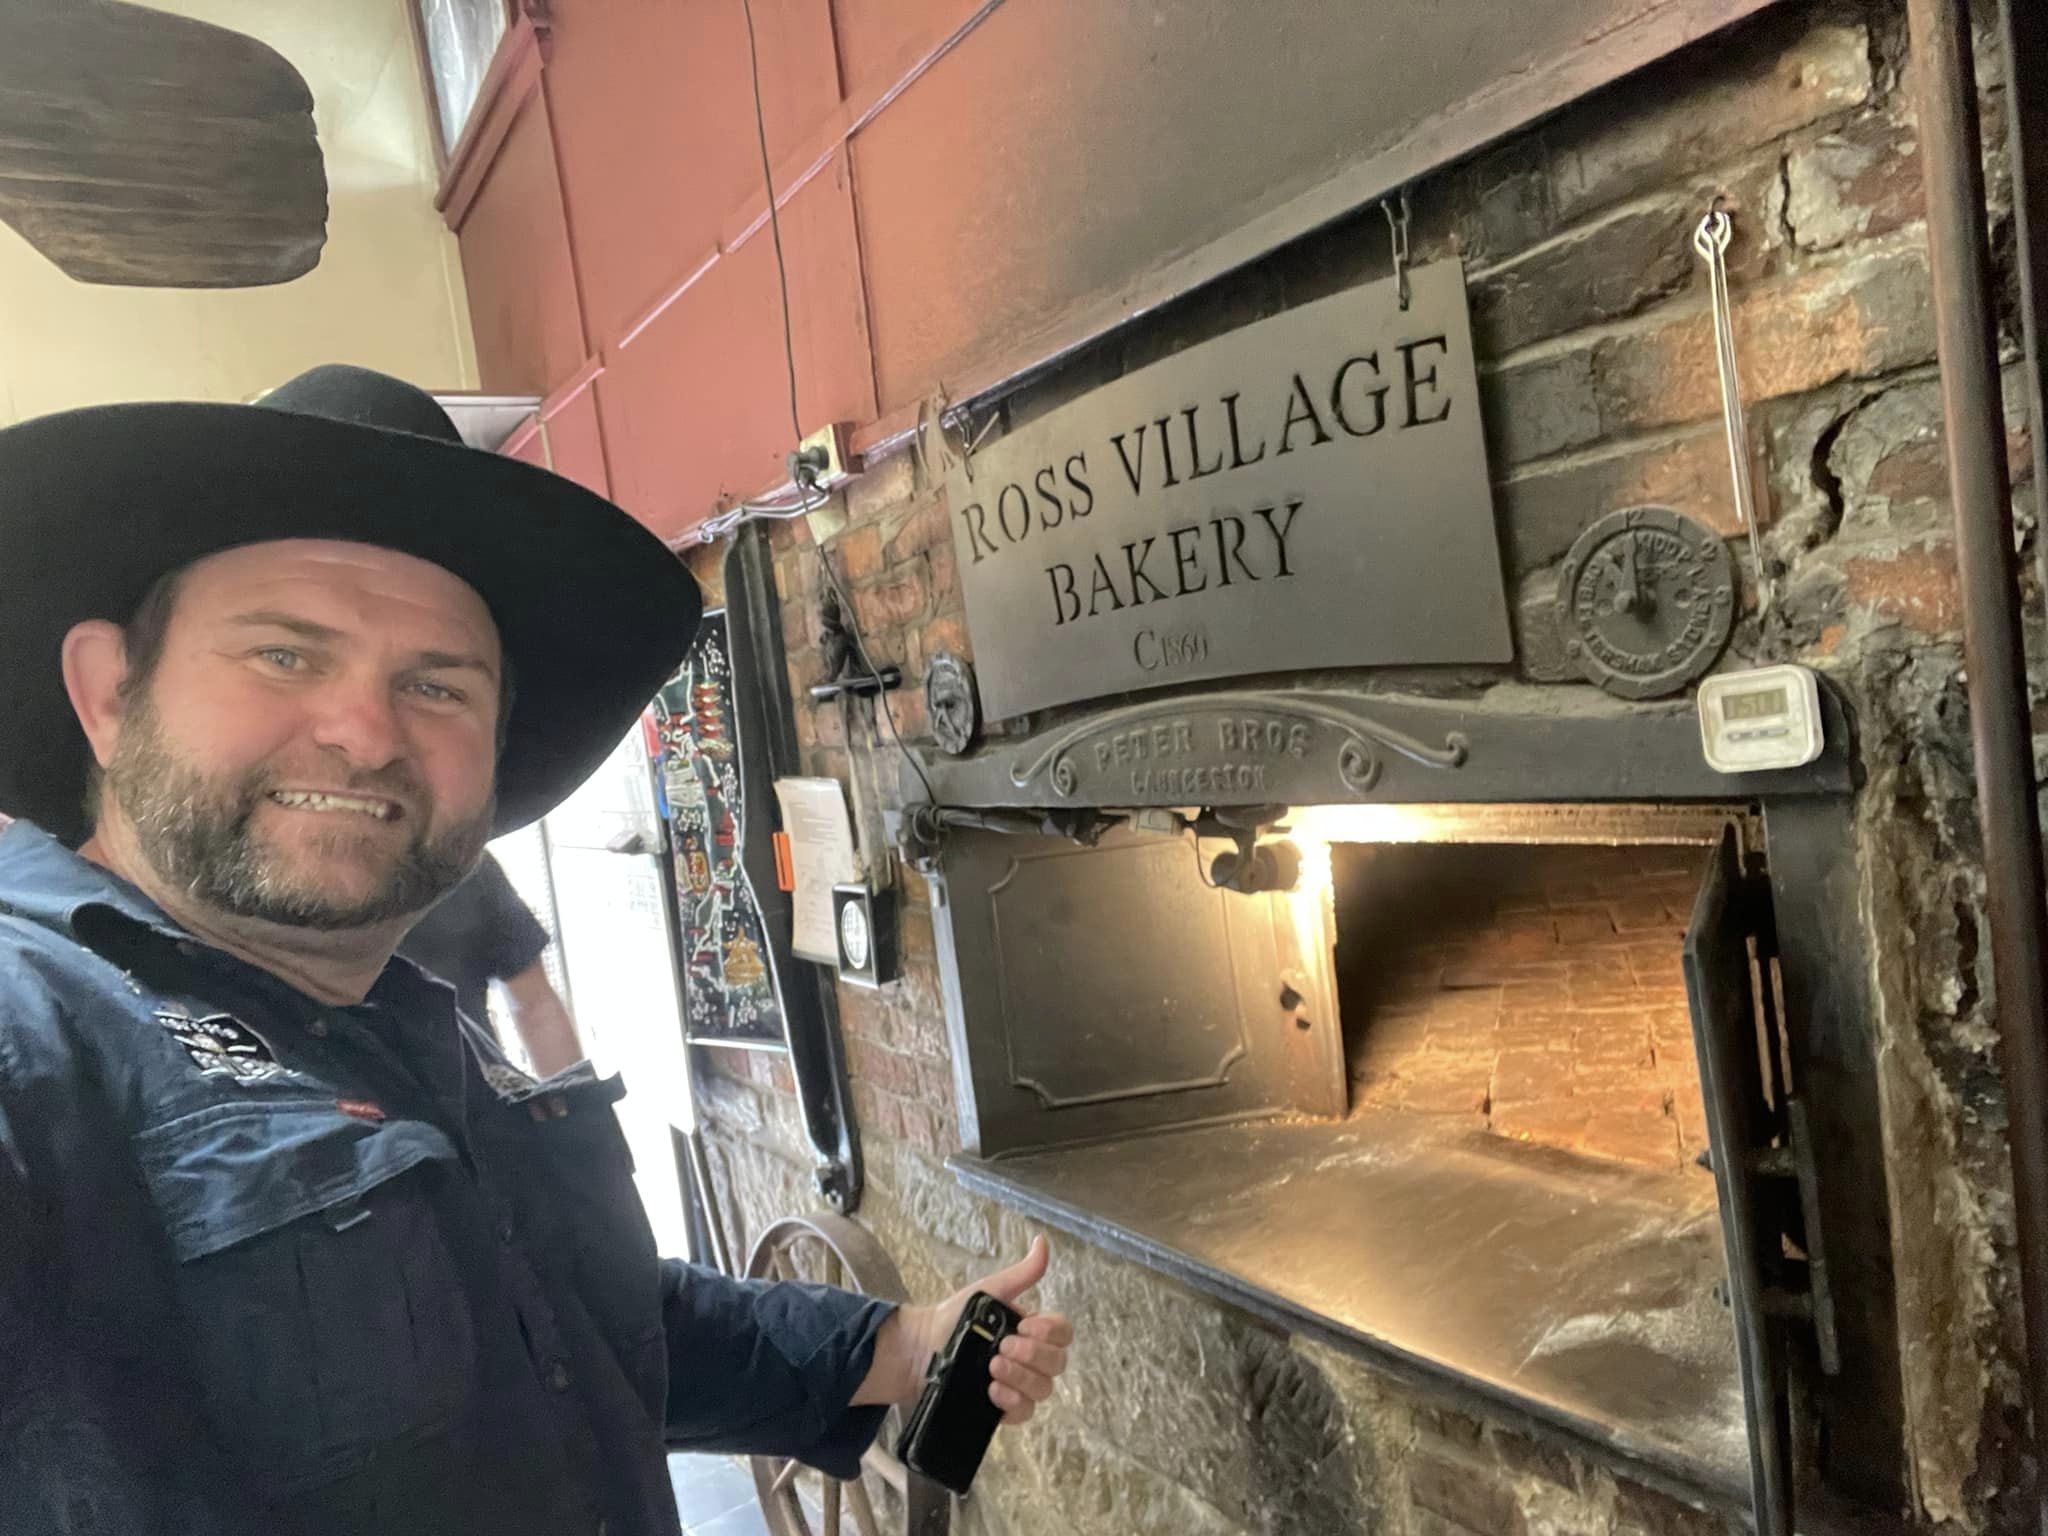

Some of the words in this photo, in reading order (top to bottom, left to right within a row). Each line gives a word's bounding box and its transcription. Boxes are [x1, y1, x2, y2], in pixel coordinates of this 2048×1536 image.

[961, 451, 1095, 564] ROSS
[1110, 335, 1453, 498] VILLAGE
[1045, 501, 1304, 626] BAKERY
[1094, 719, 1193, 774] PETER
